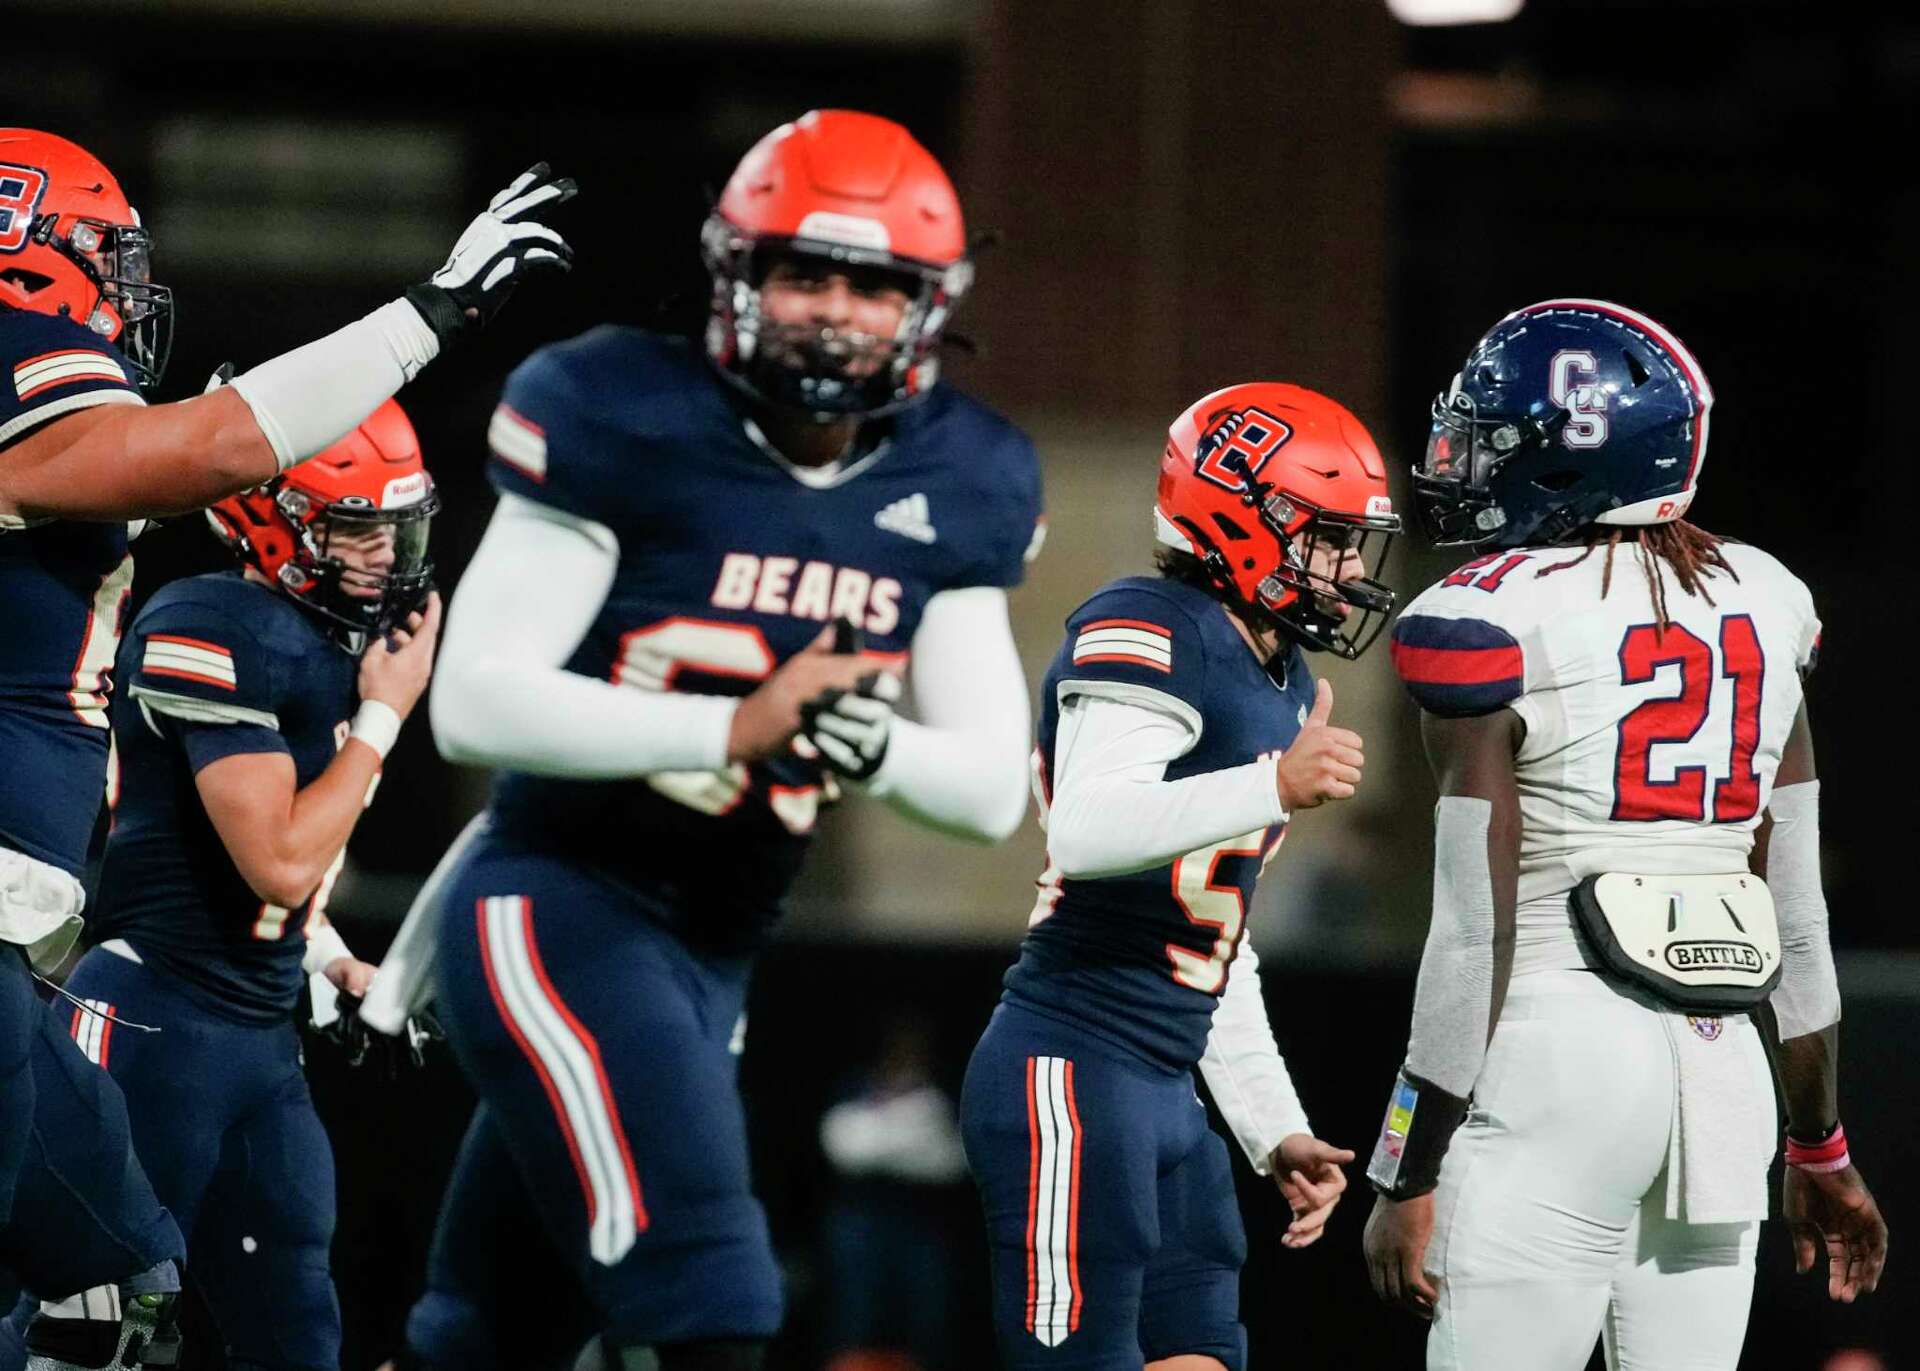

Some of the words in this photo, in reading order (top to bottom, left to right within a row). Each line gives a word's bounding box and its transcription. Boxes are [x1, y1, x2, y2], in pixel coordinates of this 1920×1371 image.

[1194, 405, 1294, 494] B
[711, 552, 903, 636] BEARS
[1440, 553, 1533, 594] 21
[1609, 613, 1766, 823] 21
[1674, 947, 1757, 967] BATTLE
